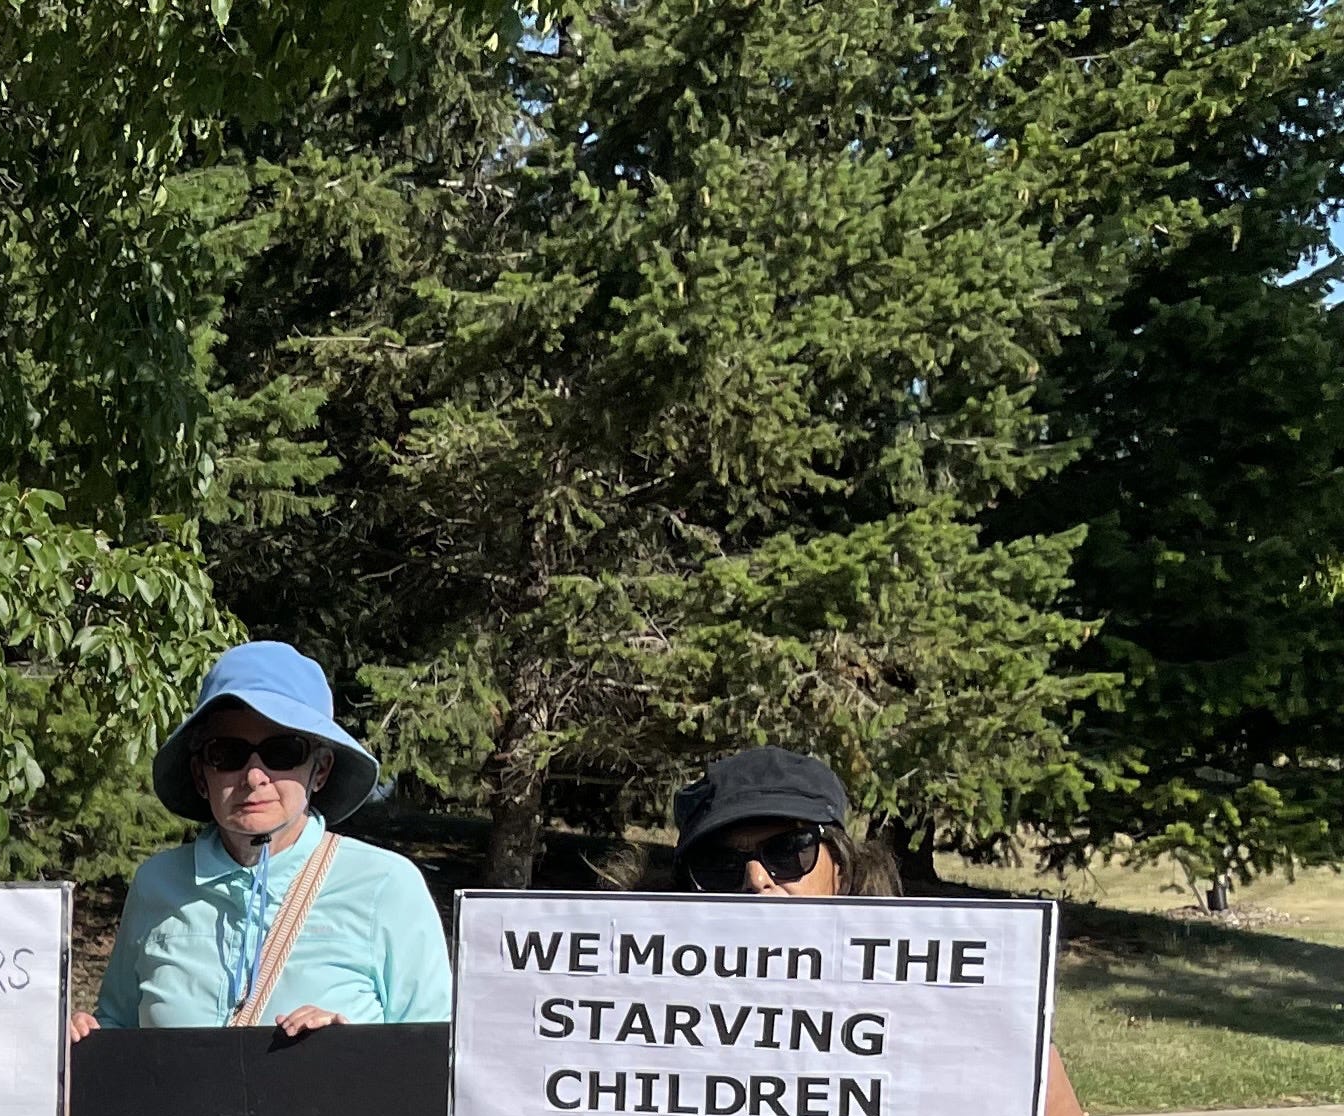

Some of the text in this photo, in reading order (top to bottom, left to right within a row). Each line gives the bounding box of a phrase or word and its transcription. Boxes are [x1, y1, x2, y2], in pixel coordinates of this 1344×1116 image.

[503, 931, 988, 985] WE Mourn THE
[539, 998, 886, 1056] STARVING
